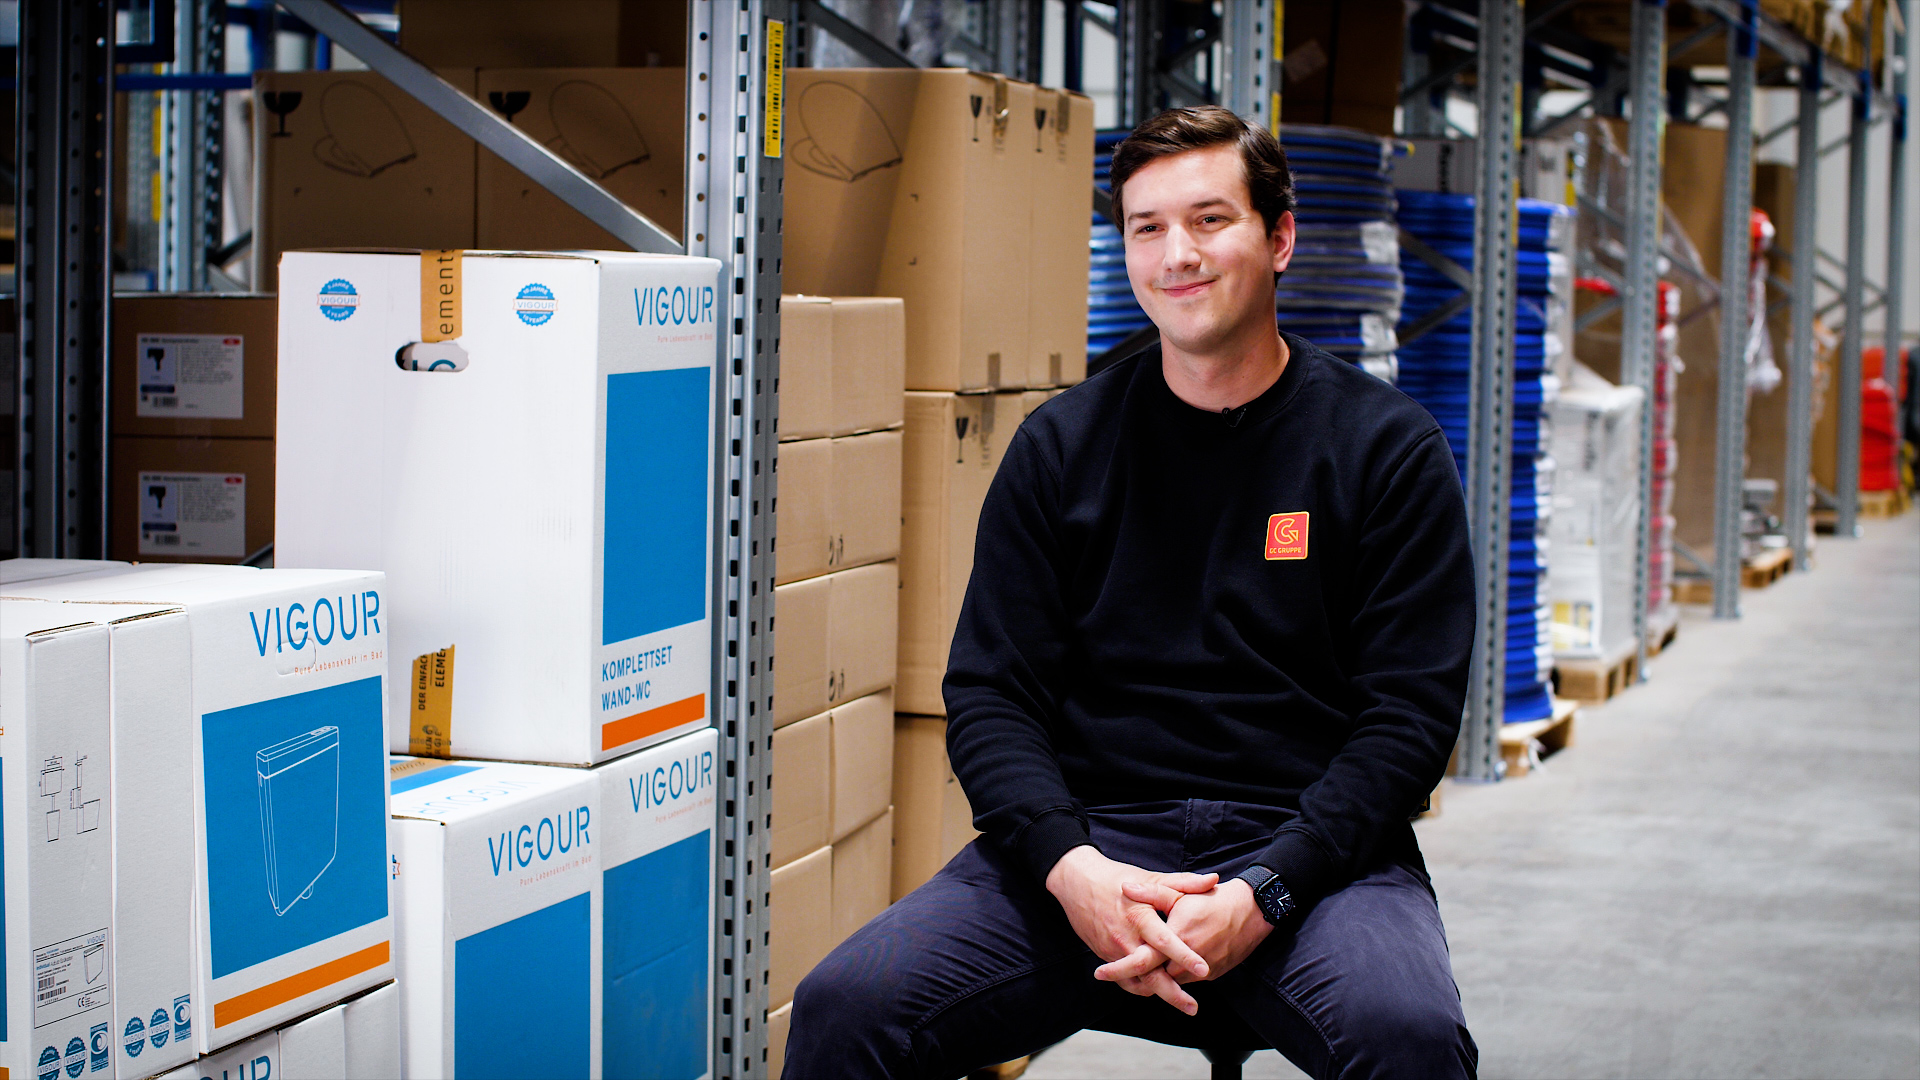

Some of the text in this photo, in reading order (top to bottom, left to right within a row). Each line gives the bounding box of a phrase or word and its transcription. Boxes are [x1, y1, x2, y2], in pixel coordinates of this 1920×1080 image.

[320, 296, 357, 304] VIGOUR
[437, 249, 454, 335] ement
[517, 301, 555, 309] VIGOUR
[634, 285, 713, 326] VIGOUR
[249, 590, 380, 657] VIGOUR
[294, 650, 383, 676] Pure Lebenskraft im Bad
[435, 648, 447, 688] ELEME
[602, 645, 672, 682] KOMPLETTSET
[418, 692, 426, 711] DER
[601, 680, 651, 712] WAND-WC
[629, 751, 712, 814] VIGOUR
[488, 806, 590, 876] VIGOUR
[520, 877, 534, 887] Pure
[536, 863, 571, 881] Lebenskraft
[582, 855, 592, 865] Bad
[87, 933, 106, 945] VIGOUR
[125, 1031, 146, 1044] VIGOUR
[150, 1022, 170, 1035] VIGOUR
[39, 1061, 60, 1075] VIGOUR
[66, 1051, 86, 1065] VIGOUR
